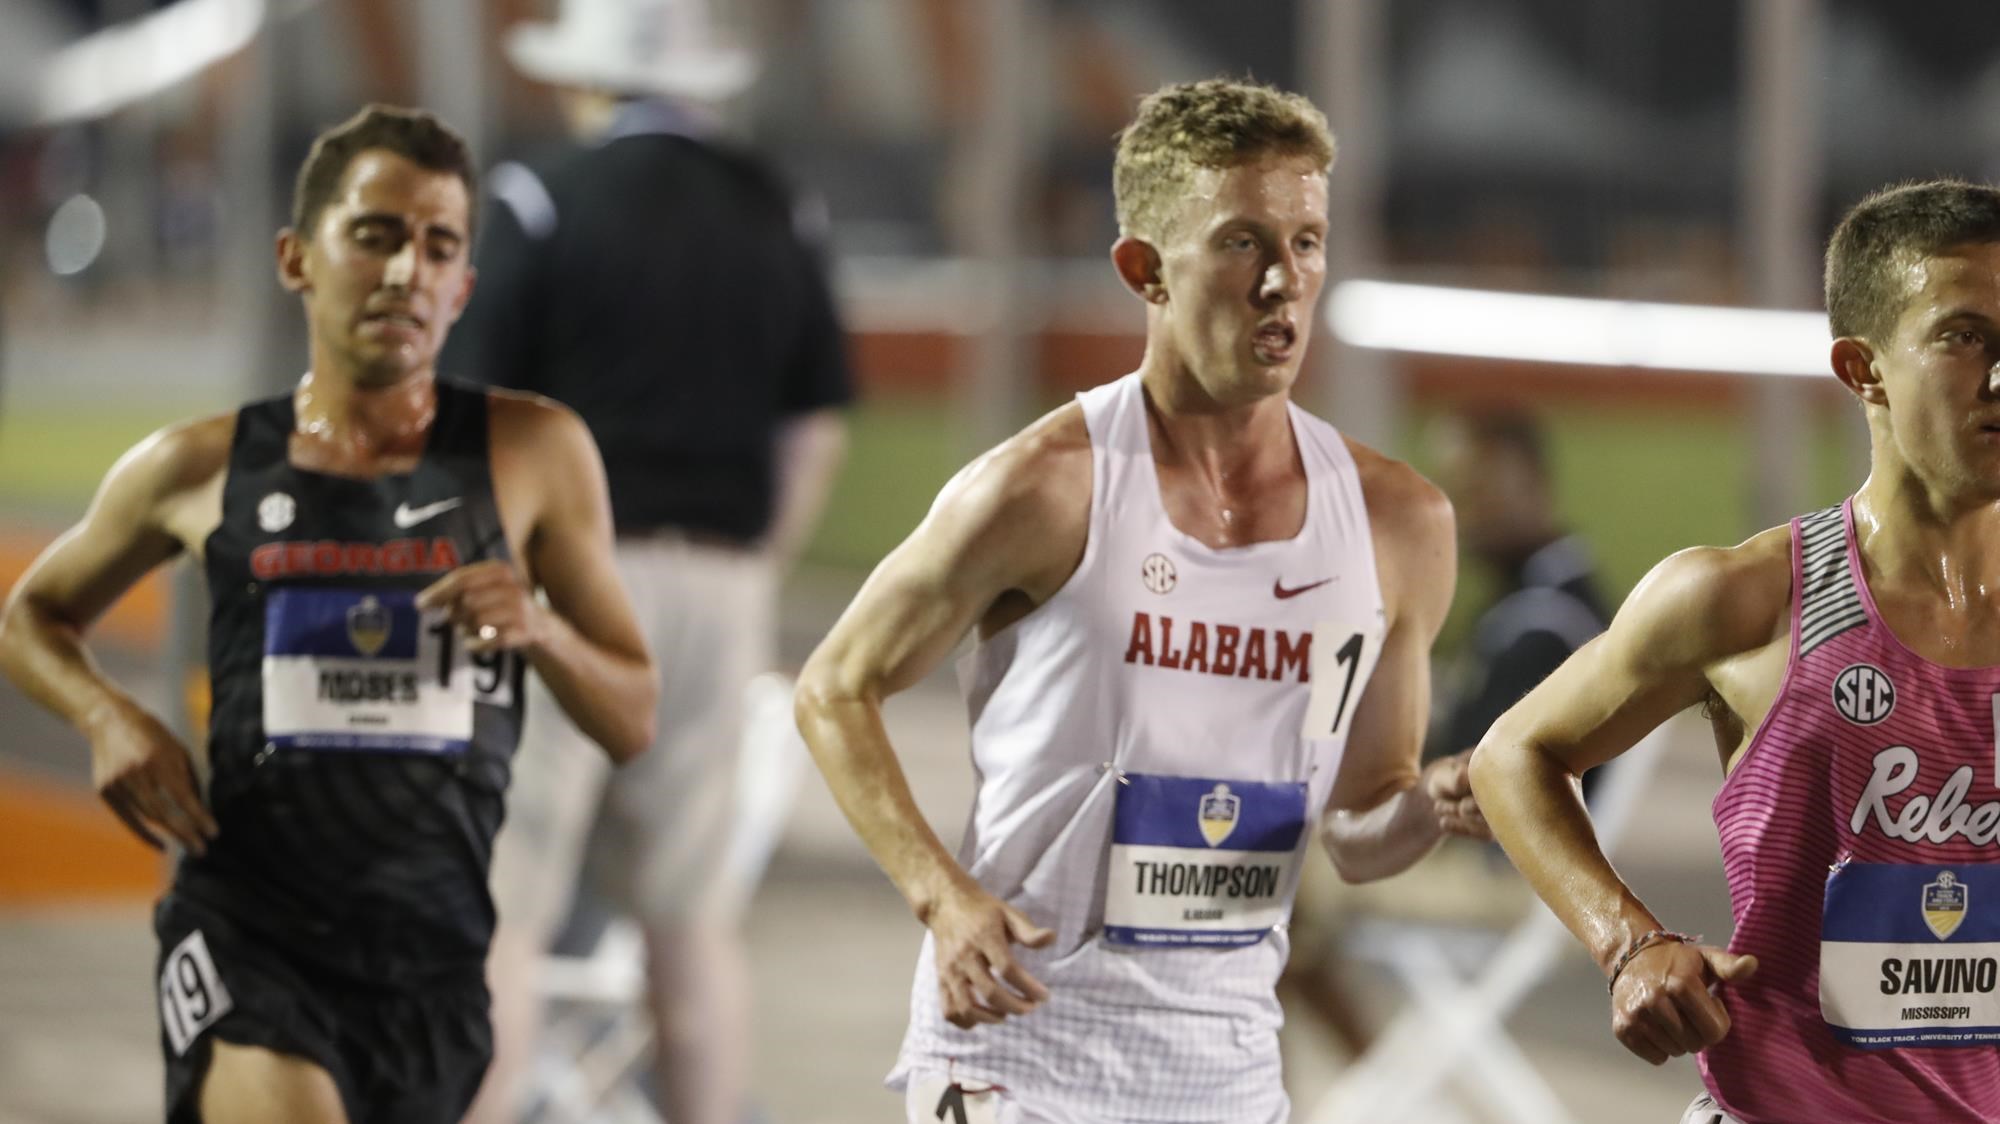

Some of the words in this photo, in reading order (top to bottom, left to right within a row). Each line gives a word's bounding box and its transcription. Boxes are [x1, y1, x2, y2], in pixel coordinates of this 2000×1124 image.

[252, 538, 459, 579] GEORGIA
[1142, 553, 1177, 594] SEC
[1124, 611, 1313, 683] ALABAM
[1331, 633, 1364, 735] 1
[1836, 666, 1892, 723] SEC
[1850, 745, 2000, 846] Rebe
[1134, 862, 1280, 898] THOMPSON
[1880, 957, 1998, 995] SAVINO
[1901, 1006, 1970, 1021] MISSISSIPPI
